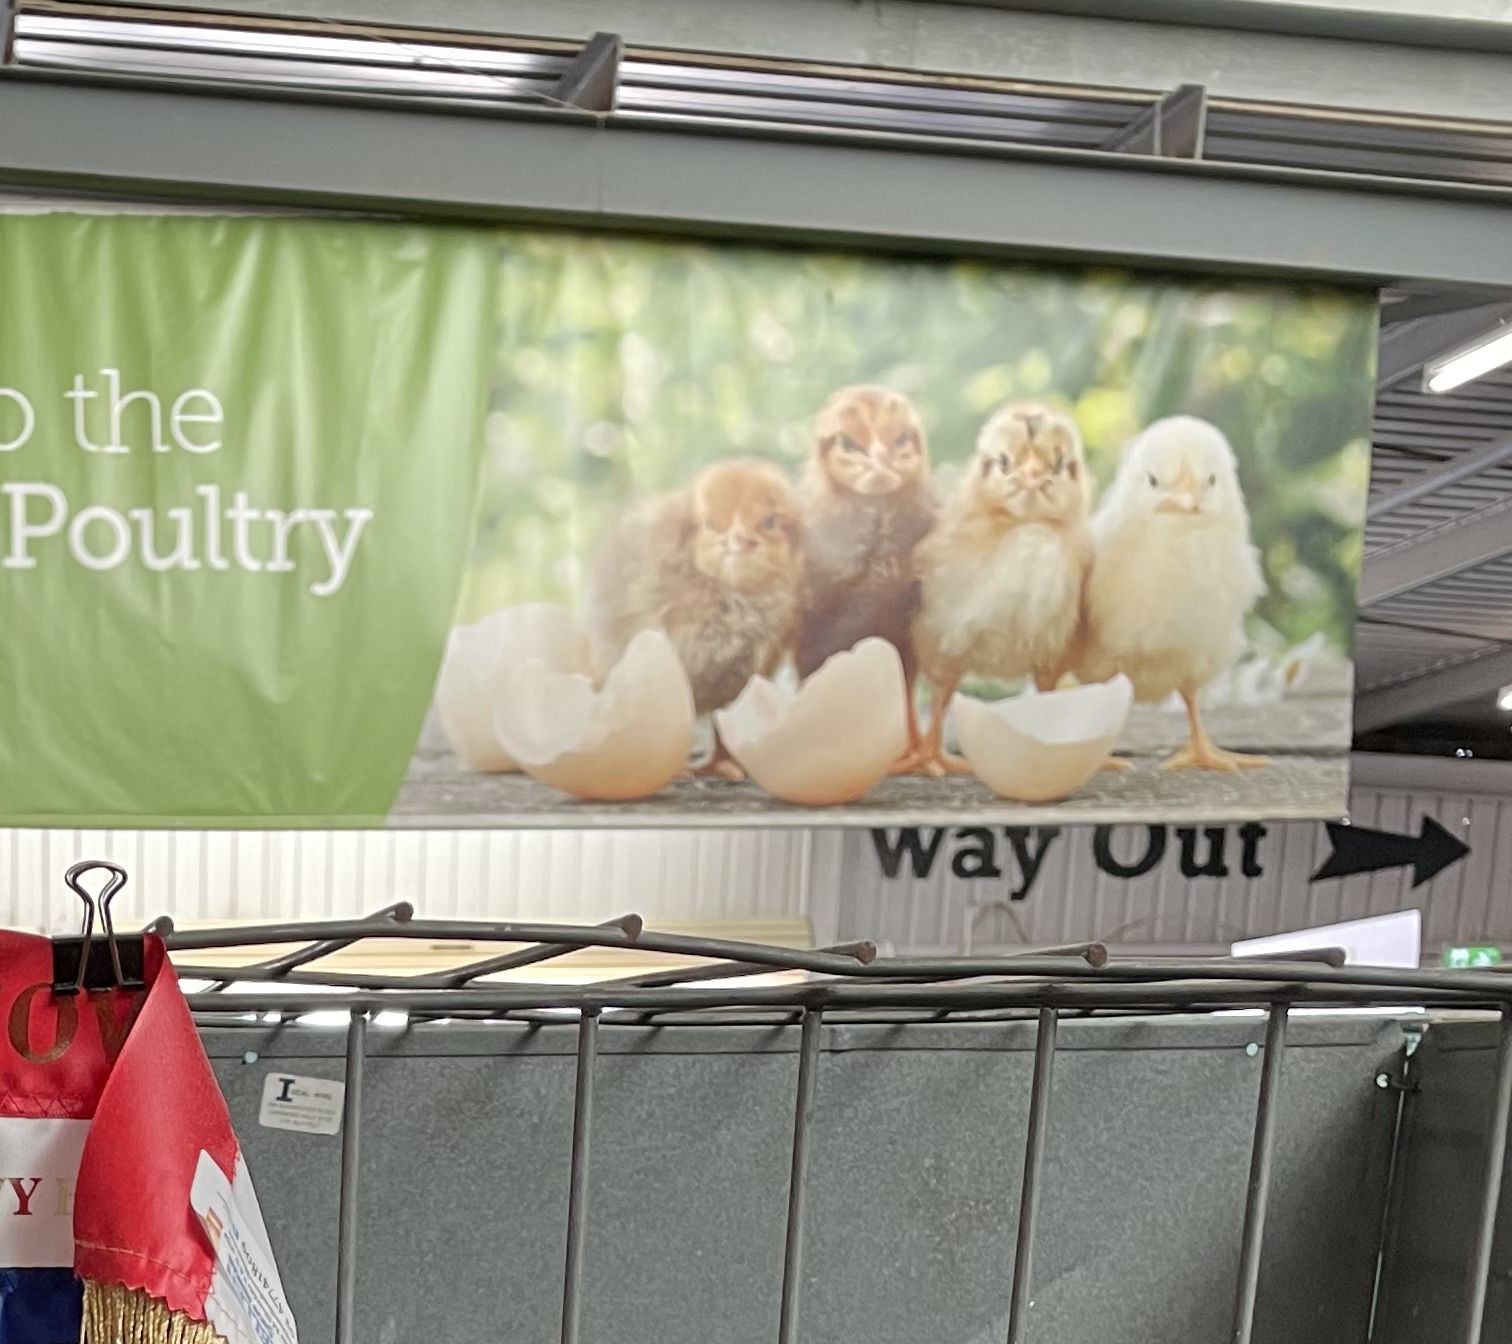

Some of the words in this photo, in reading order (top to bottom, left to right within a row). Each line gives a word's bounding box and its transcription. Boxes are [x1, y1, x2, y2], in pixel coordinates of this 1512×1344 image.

[63, 368, 226, 454] the
[0, 481, 375, 598] Poultry
[1092, 823, 1269, 879] Out
